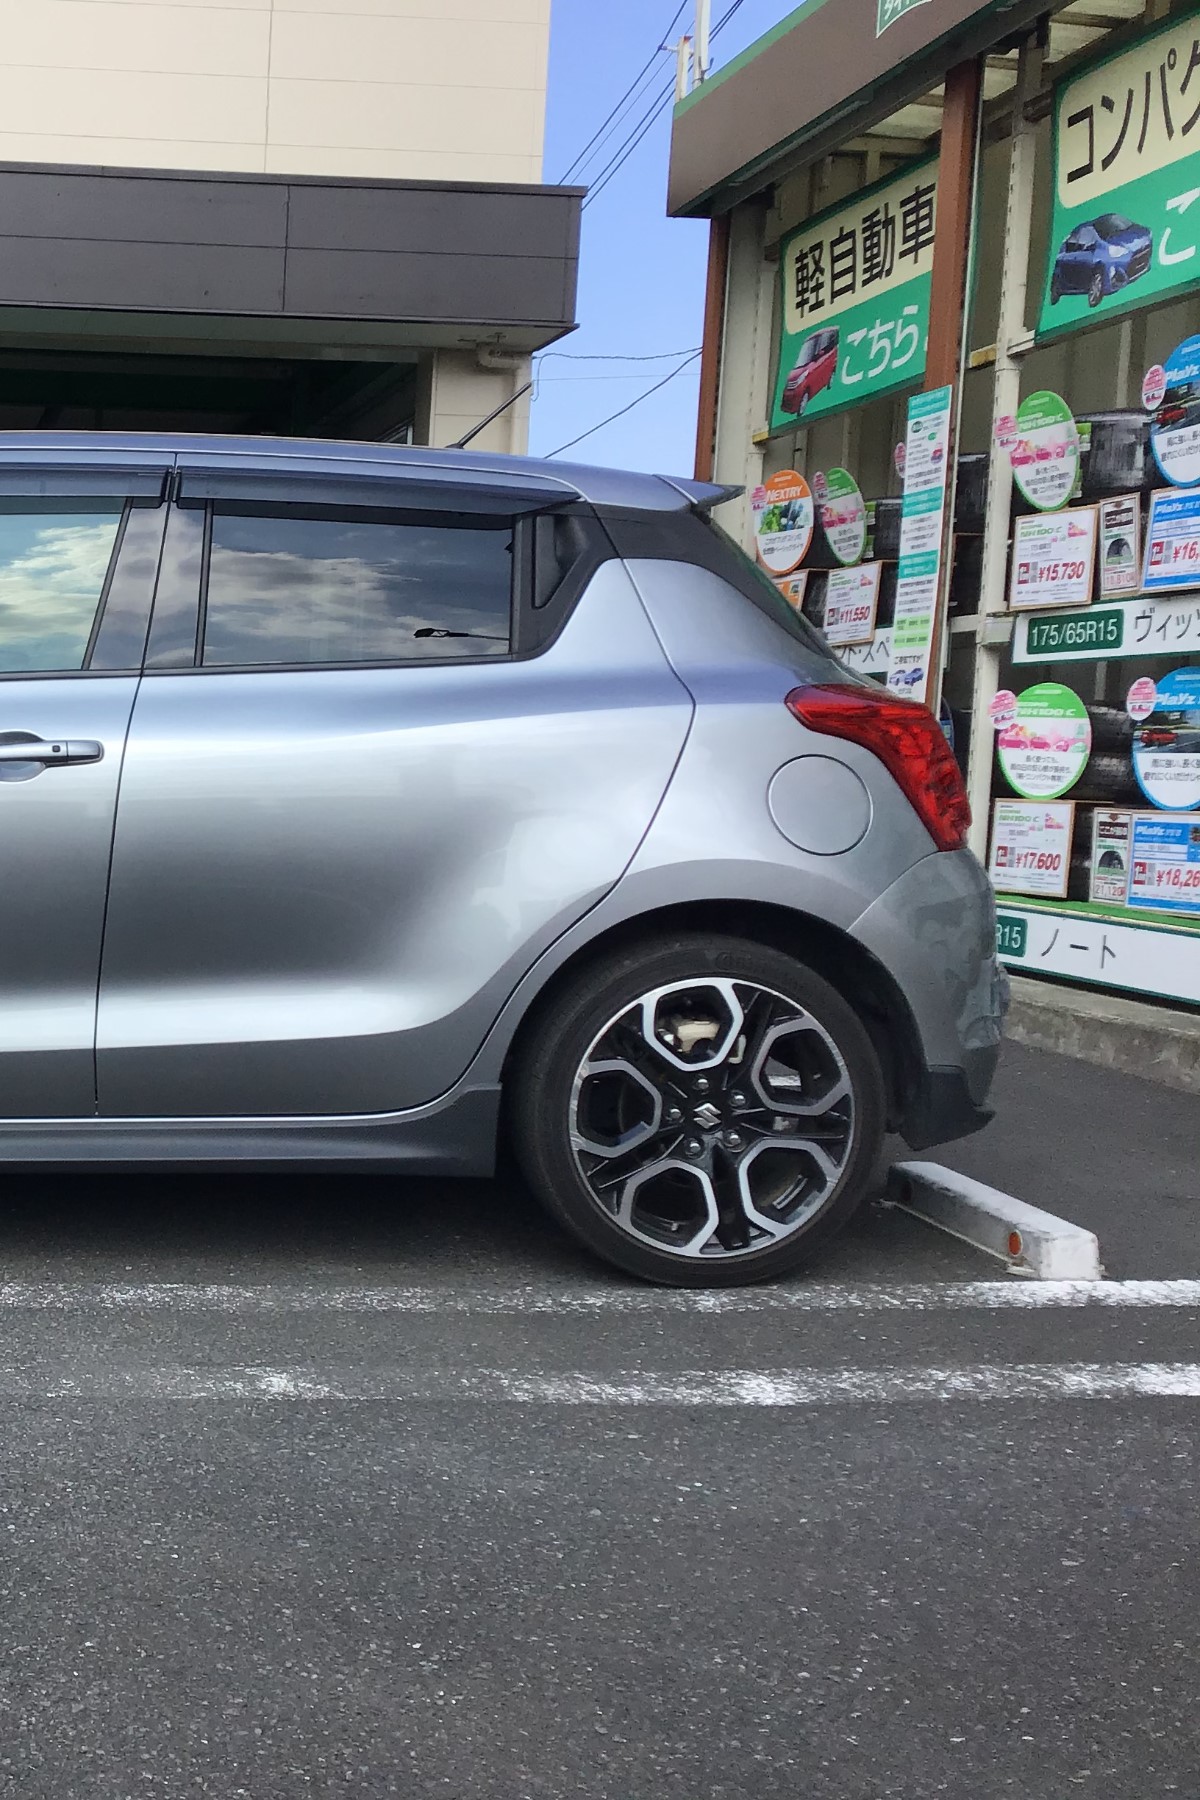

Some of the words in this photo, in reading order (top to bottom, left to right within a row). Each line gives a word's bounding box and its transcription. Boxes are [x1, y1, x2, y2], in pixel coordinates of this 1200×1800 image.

[795, 182, 936, 319] 軽自動車
[841, 304, 919, 385] こちら
[767, 485, 803, 501] NEXTRY
[1031, 618, 1118, 647] 175/65R15
[1135, 607, 1200, 643] ヴィッ
[1041, 928, 1116, 969] ノート
